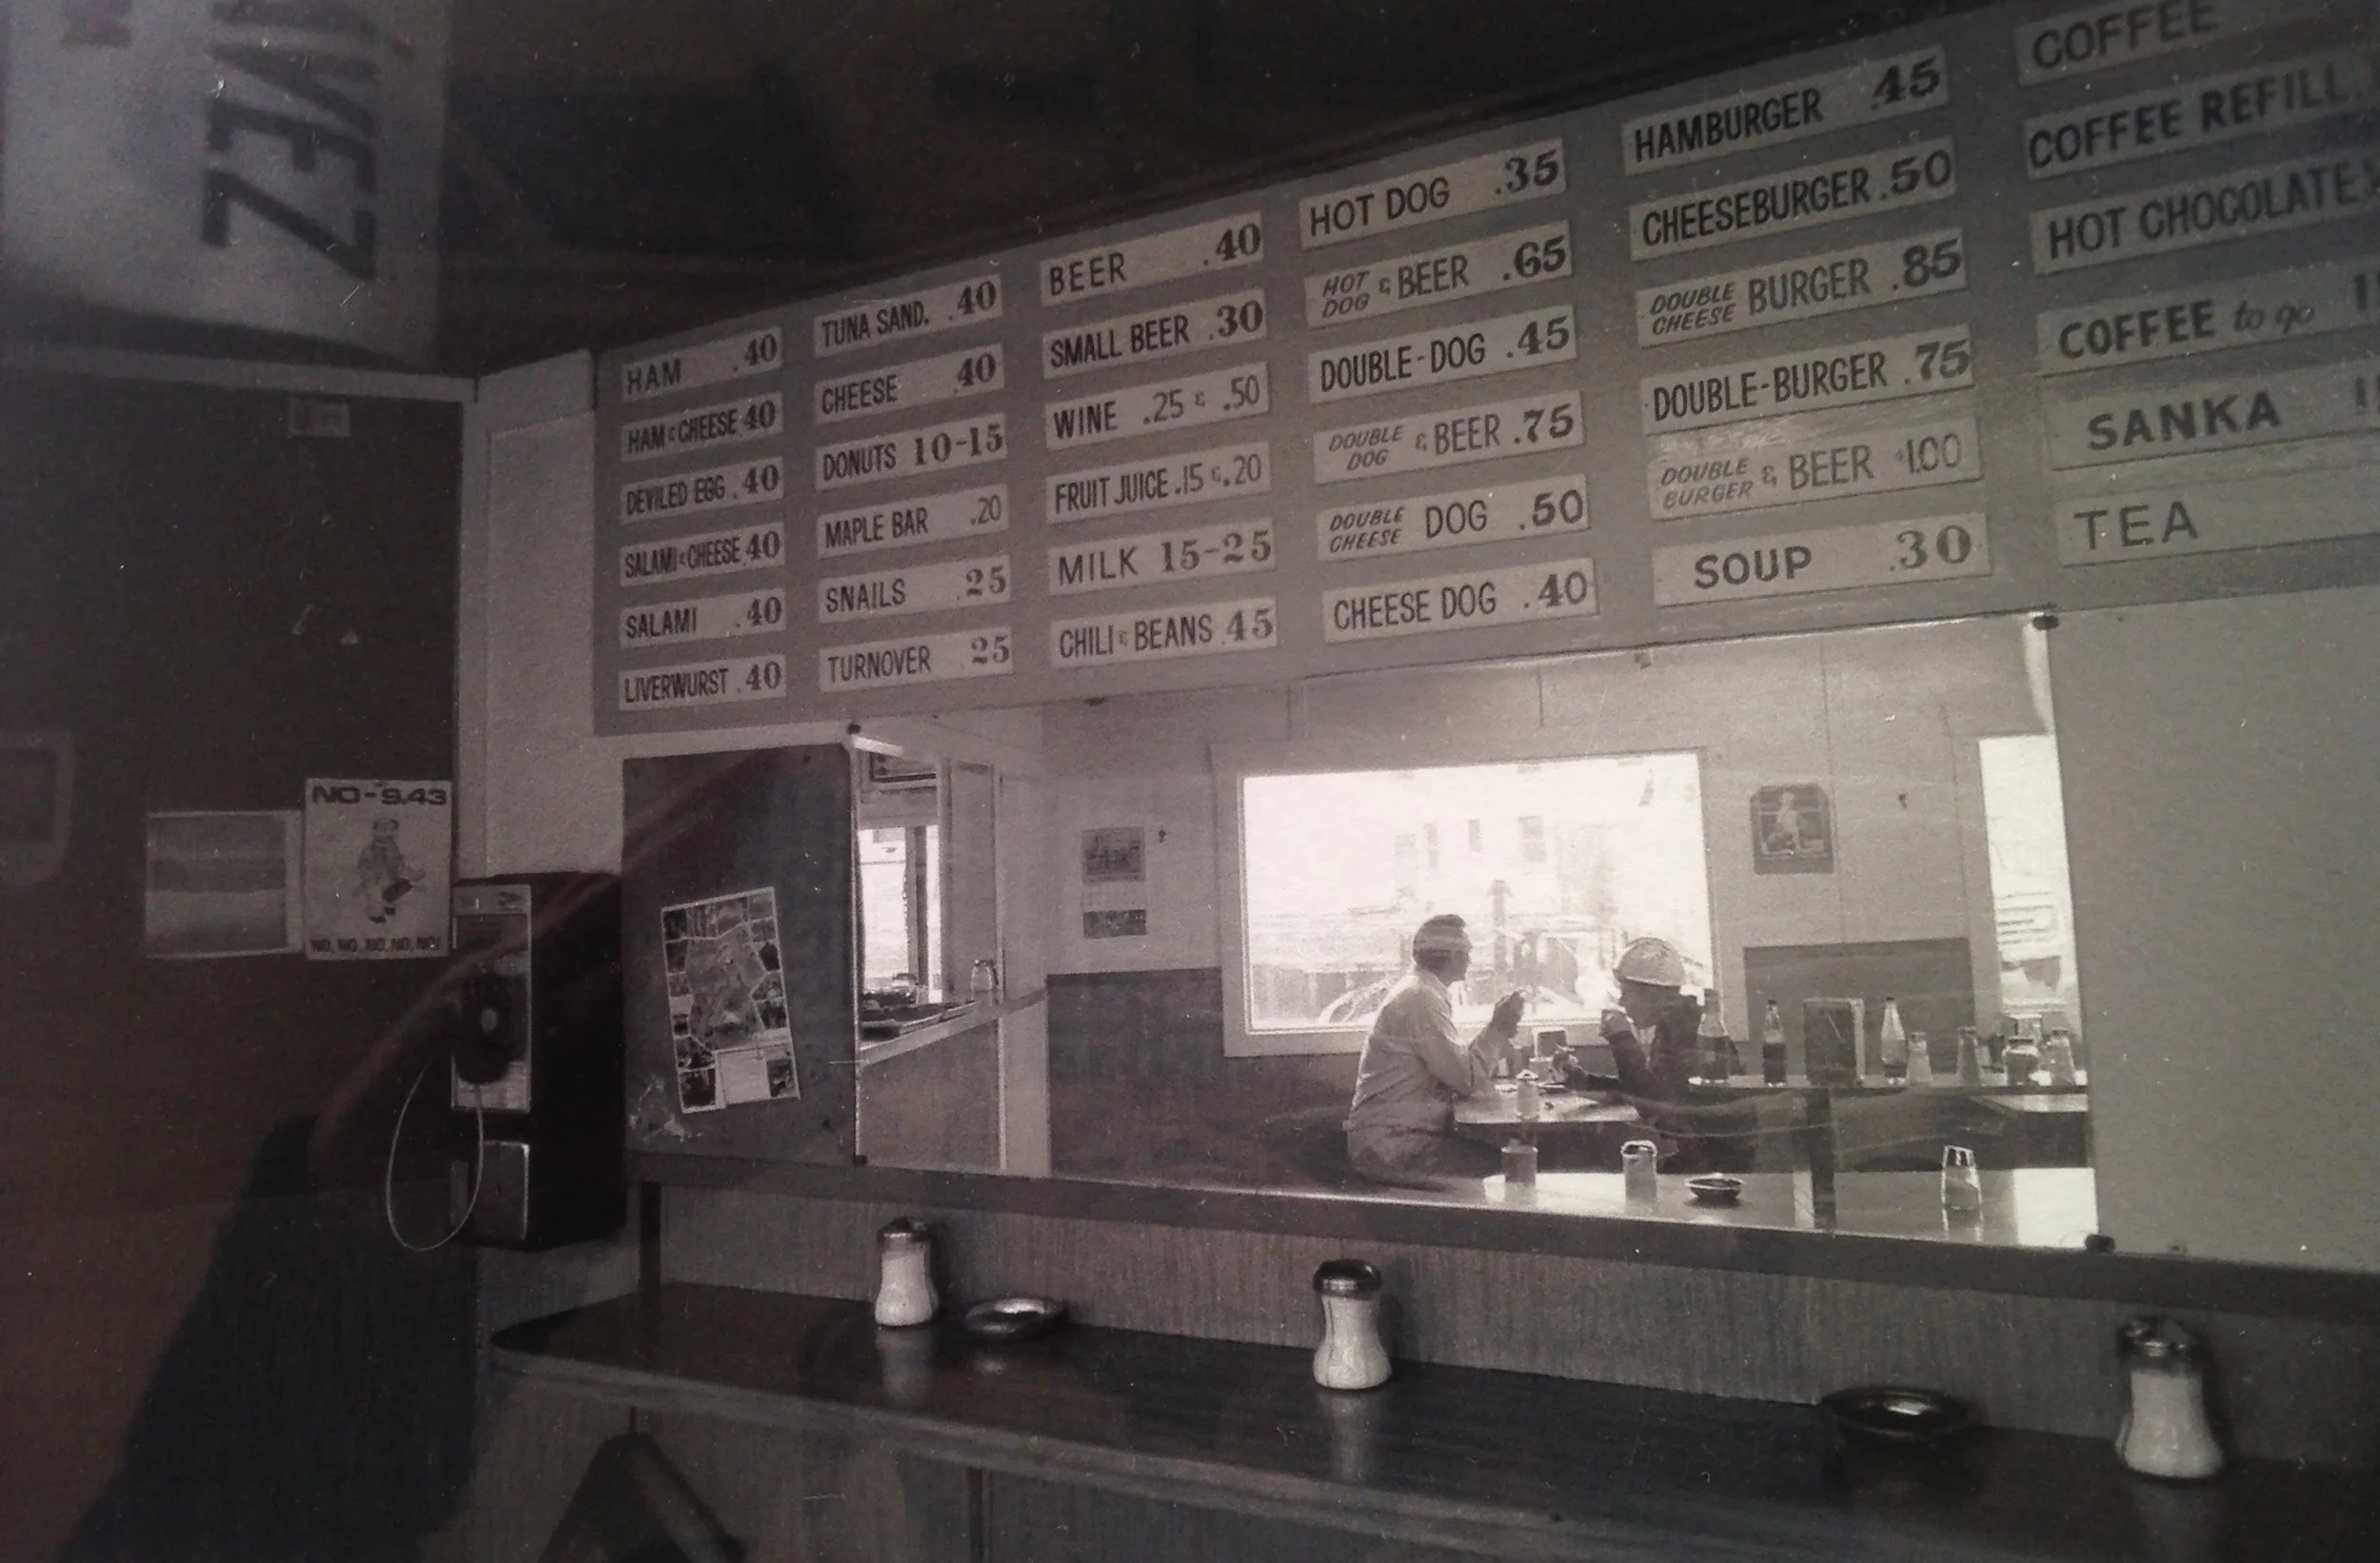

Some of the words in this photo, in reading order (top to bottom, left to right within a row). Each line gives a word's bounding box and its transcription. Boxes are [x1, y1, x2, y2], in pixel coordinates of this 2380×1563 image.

[2032, 0, 2220, 69] COFFEE
[1634, 87, 1825, 165] HAMBURGER
[1871, 55, 1941, 110] .45
[2029, 99, 2185, 168] COFFEE
[2200, 62, 2350, 134] REFILL
[1310, 193, 1375, 237] HOT
[1386, 175, 1450, 220] DOG
[1495, 148, 1559, 196] .35
[1641, 166, 1872, 247] CHEESEBURGER
[1880, 148, 1952, 201] .50
[2049, 206, 2128, 260] HOT
[2139, 159, 2360, 240] CHOCOLATE
[1049, 251, 1127, 297] BEER
[1202, 223, 1261, 267] .40
[1321, 270, 1370, 298] HOT
[1397, 254, 1470, 300] BEER
[1502, 234, 1567, 282] .65
[1748, 257, 1872, 317] BURGER
[1893, 237, 1961, 291] .85
[822, 312, 871, 347] TUNA
[876, 300, 929, 335] SAND.
[948, 280, 997, 322] .40
[1321, 292, 1370, 320] DOG
[1649, 281, 1735, 317] DOUBLE
[1652, 303, 1737, 336] CHEESE
[1050, 329, 1122, 368] SMALL
[1130, 314, 1190, 354] BEER
[1506, 316, 1570, 359] .45
[2058, 298, 2215, 360] COFFEE
[2231, 299, 2265, 331] to
[2273, 304, 2315, 334] go
[626, 357, 682, 395] HAM
[732, 334, 778, 372] .40
[1904, 338, 1970, 386] .75
[822, 373, 898, 415] CHEESE
[1053, 400, 1118, 440] WINE
[1143, 388, 1184, 425] .25
[1222, 374, 1260, 411] .50
[1328, 424, 1405, 452] DOUBLE
[1433, 413, 1501, 456] BEER
[1513, 403, 1575, 445] .75
[2086, 390, 2282, 451] SANKA
[823, 442, 897, 482] DONUTS
[913, 424, 1003, 465] 10-15
[1346, 448, 1390, 472] DOG
[1660, 456, 1750, 487] DOUBLE
[1789, 444, 1875, 490] BEER
[625, 481, 688, 515] DEVILED
[694, 475, 726, 505] EGG
[732, 464, 780, 500] .40
[1055, 476, 1111, 514] FRUIT
[1114, 467, 1169, 505] JUICE
[1175, 463, 1204, 496] .15
[1222, 453, 1262, 487] .20
[1662, 480, 1755, 510] BURGER
[824, 513, 884, 548] MAPLE
[891, 506, 929, 538] BAR
[969, 494, 1002, 525] .20
[1329, 505, 1406, 532] DOUBLE
[1425, 499, 1488, 540] DOG
[1519, 488, 1585, 531] .50
[2073, 501, 2200, 551] TEA
[1058, 546, 1139, 585] MILK
[1161, 529, 1272, 573] 15-25
[1329, 527, 1403, 554] CHEESE
[1694, 544, 1813, 590] SOUP
[1889, 524, 1972, 572] .30
[625, 606, 698, 640] SALAMI
[735, 596, 783, 628] .40
[825, 578, 906, 614] SNAILS
[1333, 588, 1433, 631] CHEESE
[1440, 582, 1497, 621] DOG
[1524, 571, 1588, 609] .40
[1059, 623, 1114, 659] CHILI
[1134, 613, 1213, 652] BEANS
[624, 667, 729, 703] LIVERWURST
[736, 661, 782, 694] .40
[827, 645, 932, 683] TURNOVER
